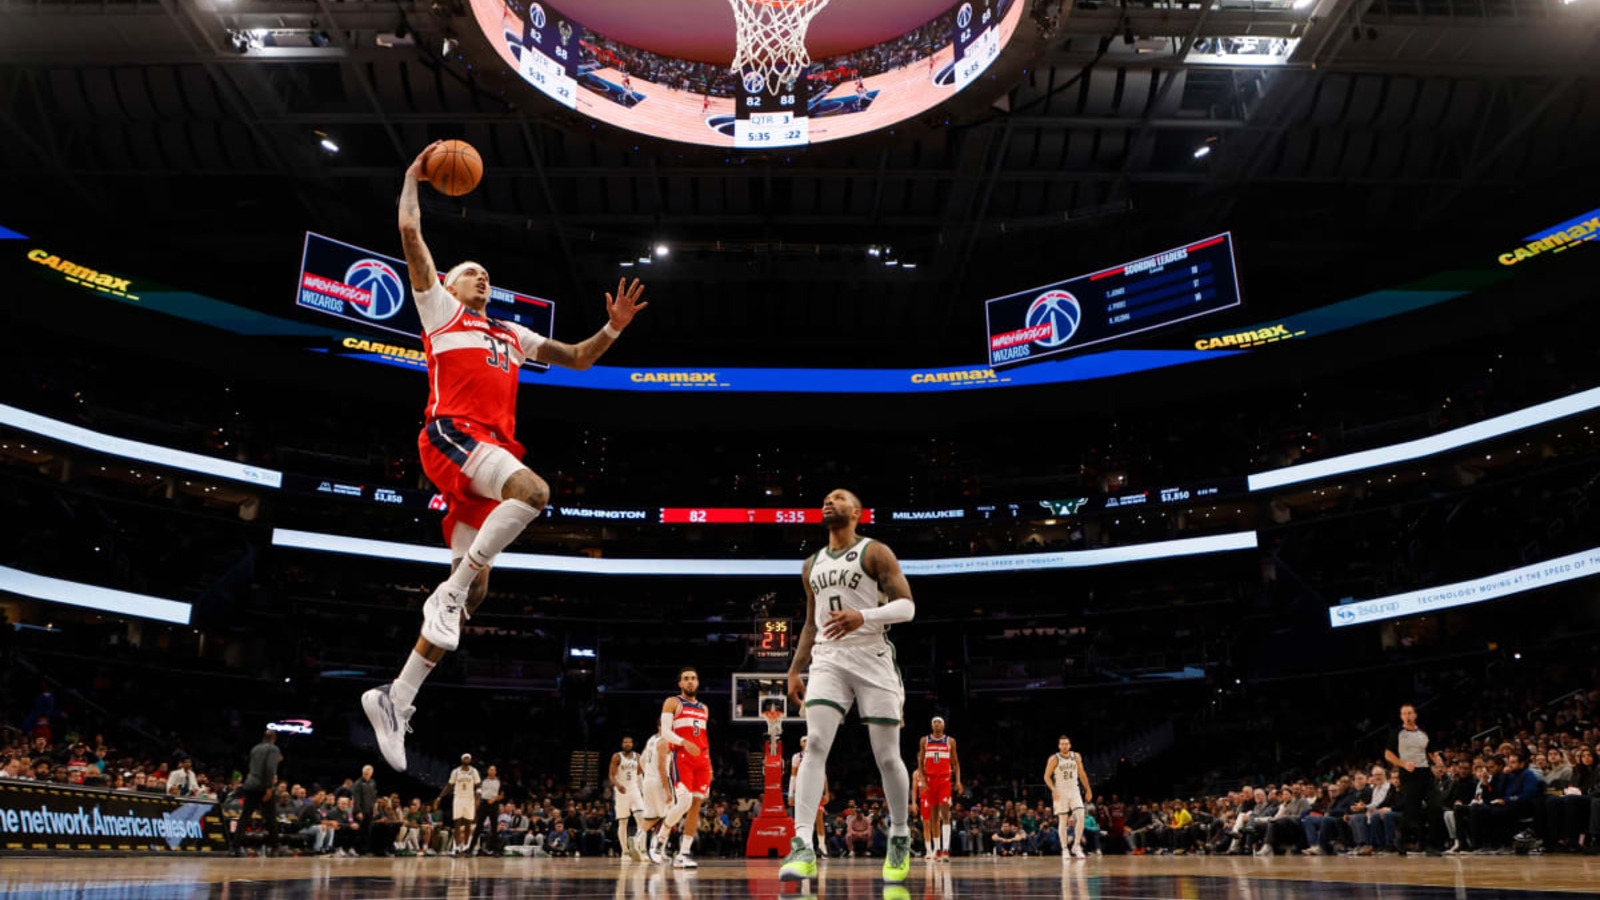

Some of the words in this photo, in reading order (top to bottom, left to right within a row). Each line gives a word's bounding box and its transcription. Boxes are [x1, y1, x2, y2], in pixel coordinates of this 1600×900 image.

[530, 28, 542, 44] 82
[960, 28, 972, 43] 82
[555, 45, 568, 60] 88
[746, 96, 762, 107] 82
[780, 94, 796, 106] 88
[752, 115, 774, 124] QTR
[748, 132, 770, 141] 5:35
[1156, 248, 1189, 266] LEADERS
[302, 289, 344, 312] WIZARDS
[484, 335, 509, 373] 33
[993, 343, 1031, 363] WIZARDS
[1161, 490, 1190, 503] $3,850
[560, 507, 646, 519] WASHINGTON
[689, 511, 707, 523] 82
[776, 510, 805, 523] 5:35
[892, 509, 965, 520] MILWAUKEE
[810, 569, 863, 596] BUCKS
[1417, 588, 1477, 605] TECHNOLOGY
[1479, 580, 1512, 594] MOVING
[1513, 576, 1524, 585] AT
[1525, 571, 1542, 582] THE
[1544, 564, 1572, 577] SPEED
[1574, 560, 1586, 570] OF
[829, 595, 842, 612] 0
[765, 621, 788, 632] 5:35
[762, 632, 785, 649] 21
[693, 720, 700, 736] 5
[1063, 770, 1074, 780] 24
[20, 804, 92, 834] network
[93, 806, 153, 837] America
[152, 812, 187, 838] relies
[187, 820, 204, 839] on
